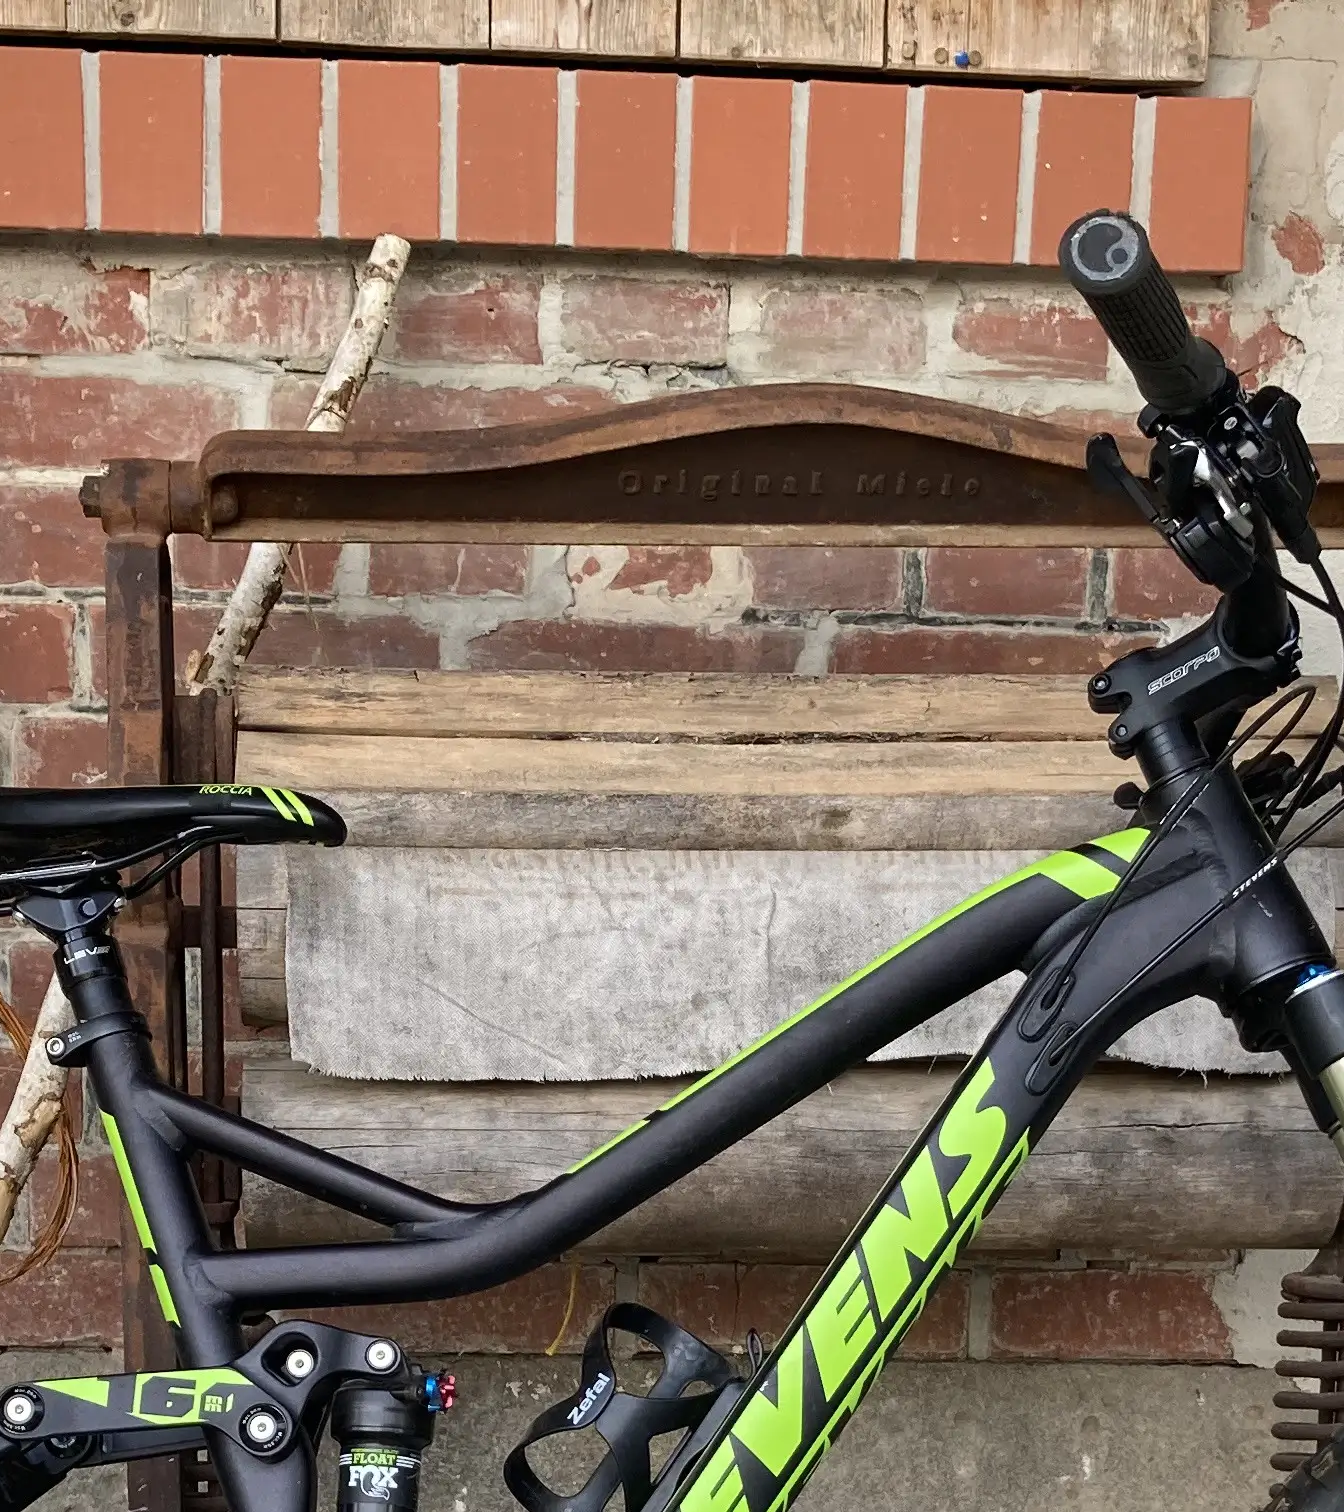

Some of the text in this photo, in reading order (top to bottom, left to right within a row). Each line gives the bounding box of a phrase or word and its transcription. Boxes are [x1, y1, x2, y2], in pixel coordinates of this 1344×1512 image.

[617, 468, 981, 500] Original Miele
[199, 784, 253, 796] ROCCIA
[1232, 856, 1278, 899] STEVENS
[566, 1372, 612, 1426] Zefal
[352, 1452, 396, 1466] FLOAT
[348, 1464, 399, 1501] FOX
